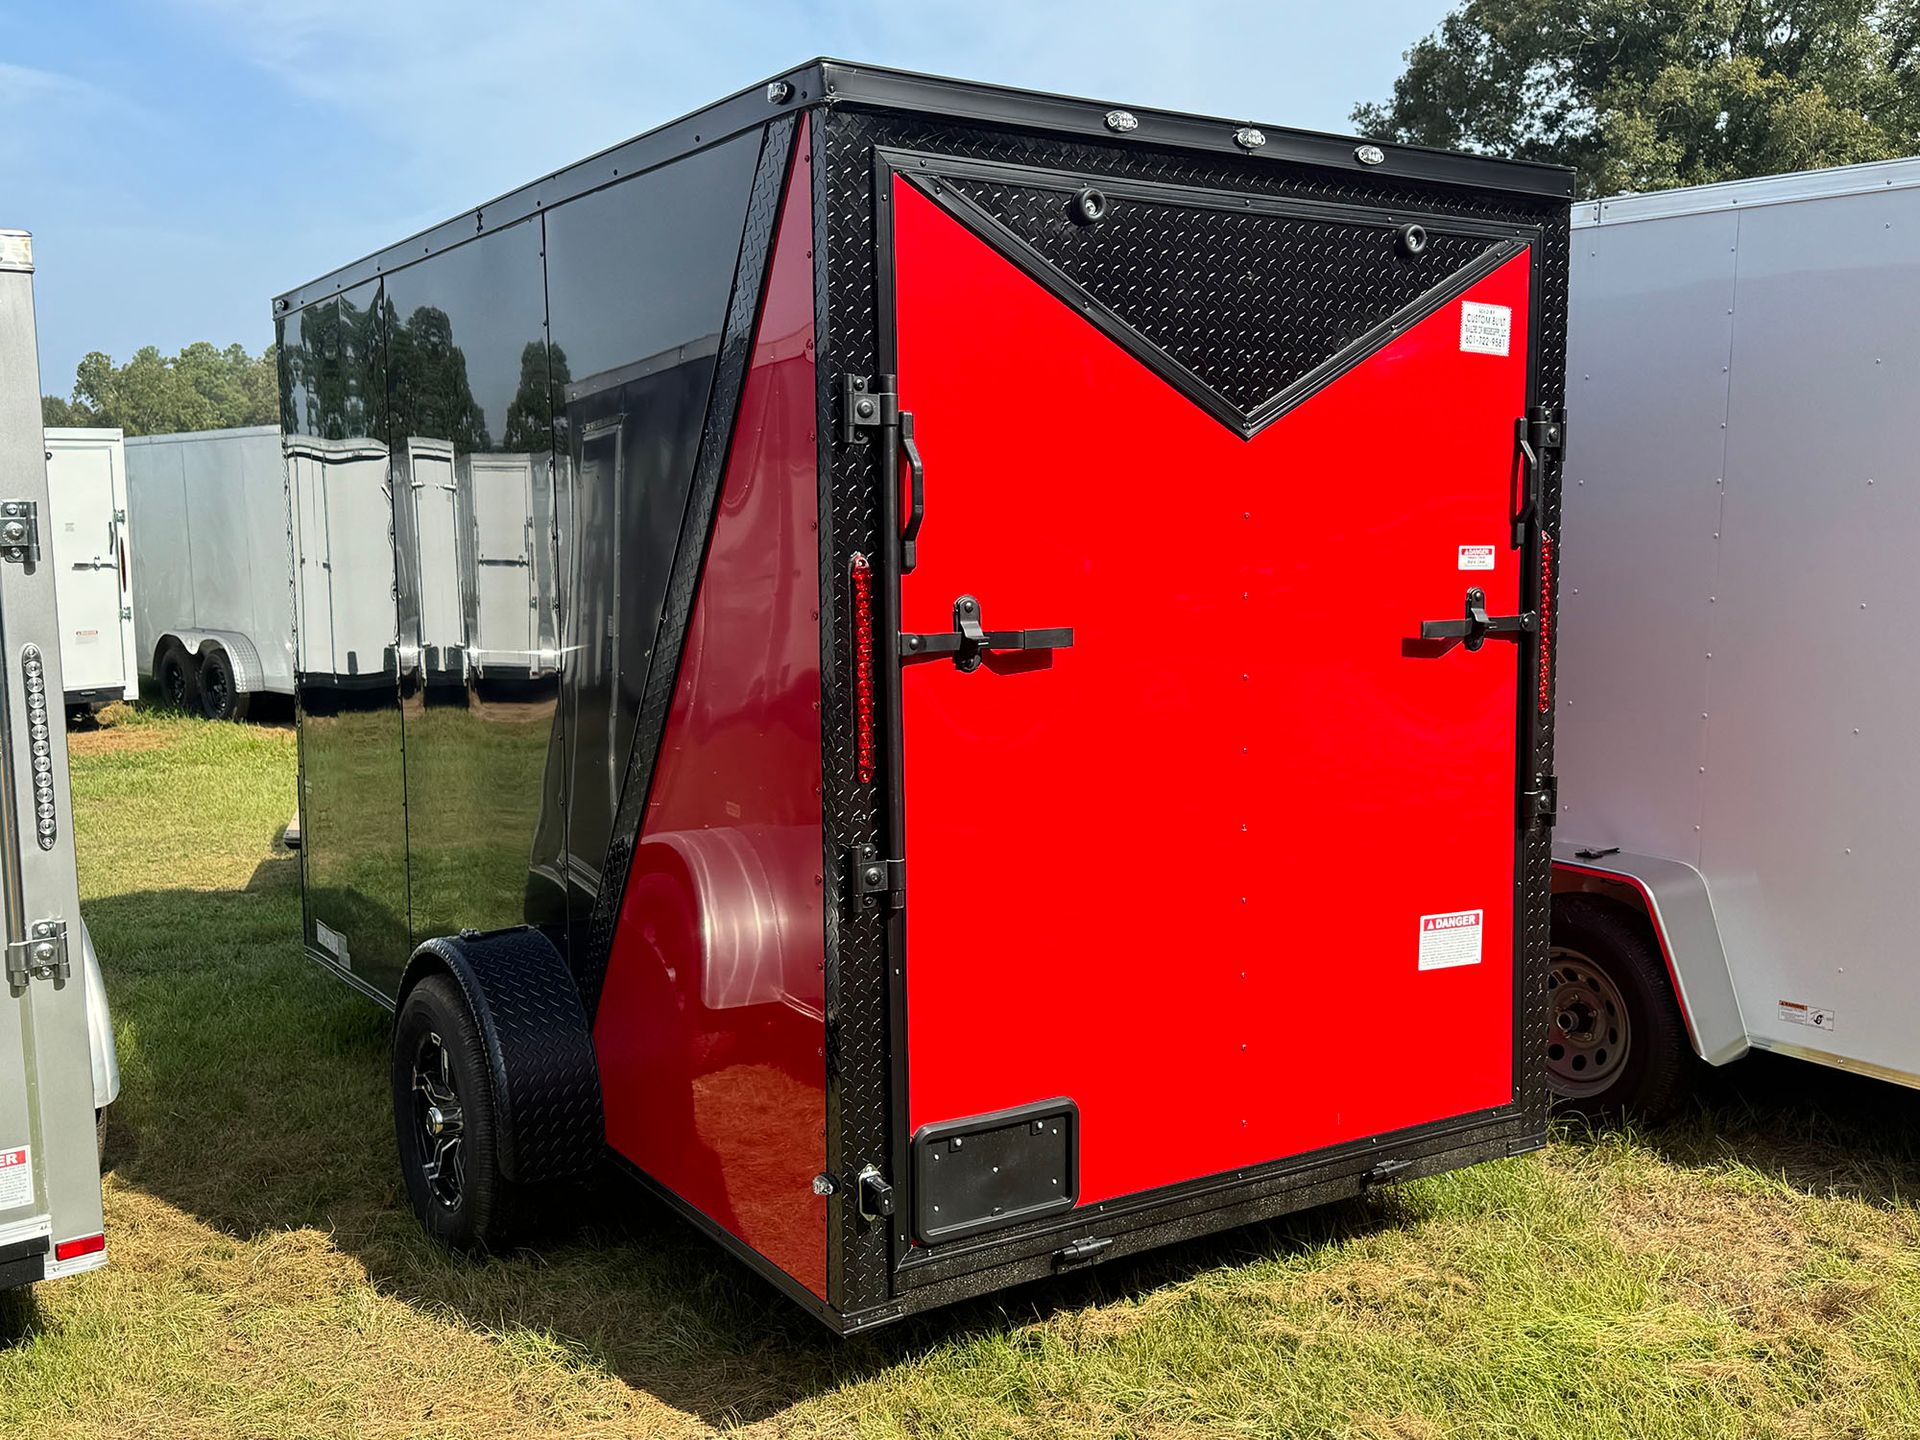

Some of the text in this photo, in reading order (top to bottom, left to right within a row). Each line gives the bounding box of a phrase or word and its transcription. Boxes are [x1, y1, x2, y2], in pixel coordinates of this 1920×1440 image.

[1466, 313, 1506, 327] CUSTOM BUILT
[1465, 334, 1506, 348] 601-722-9581
[1435, 915, 1476, 929] DANGER
